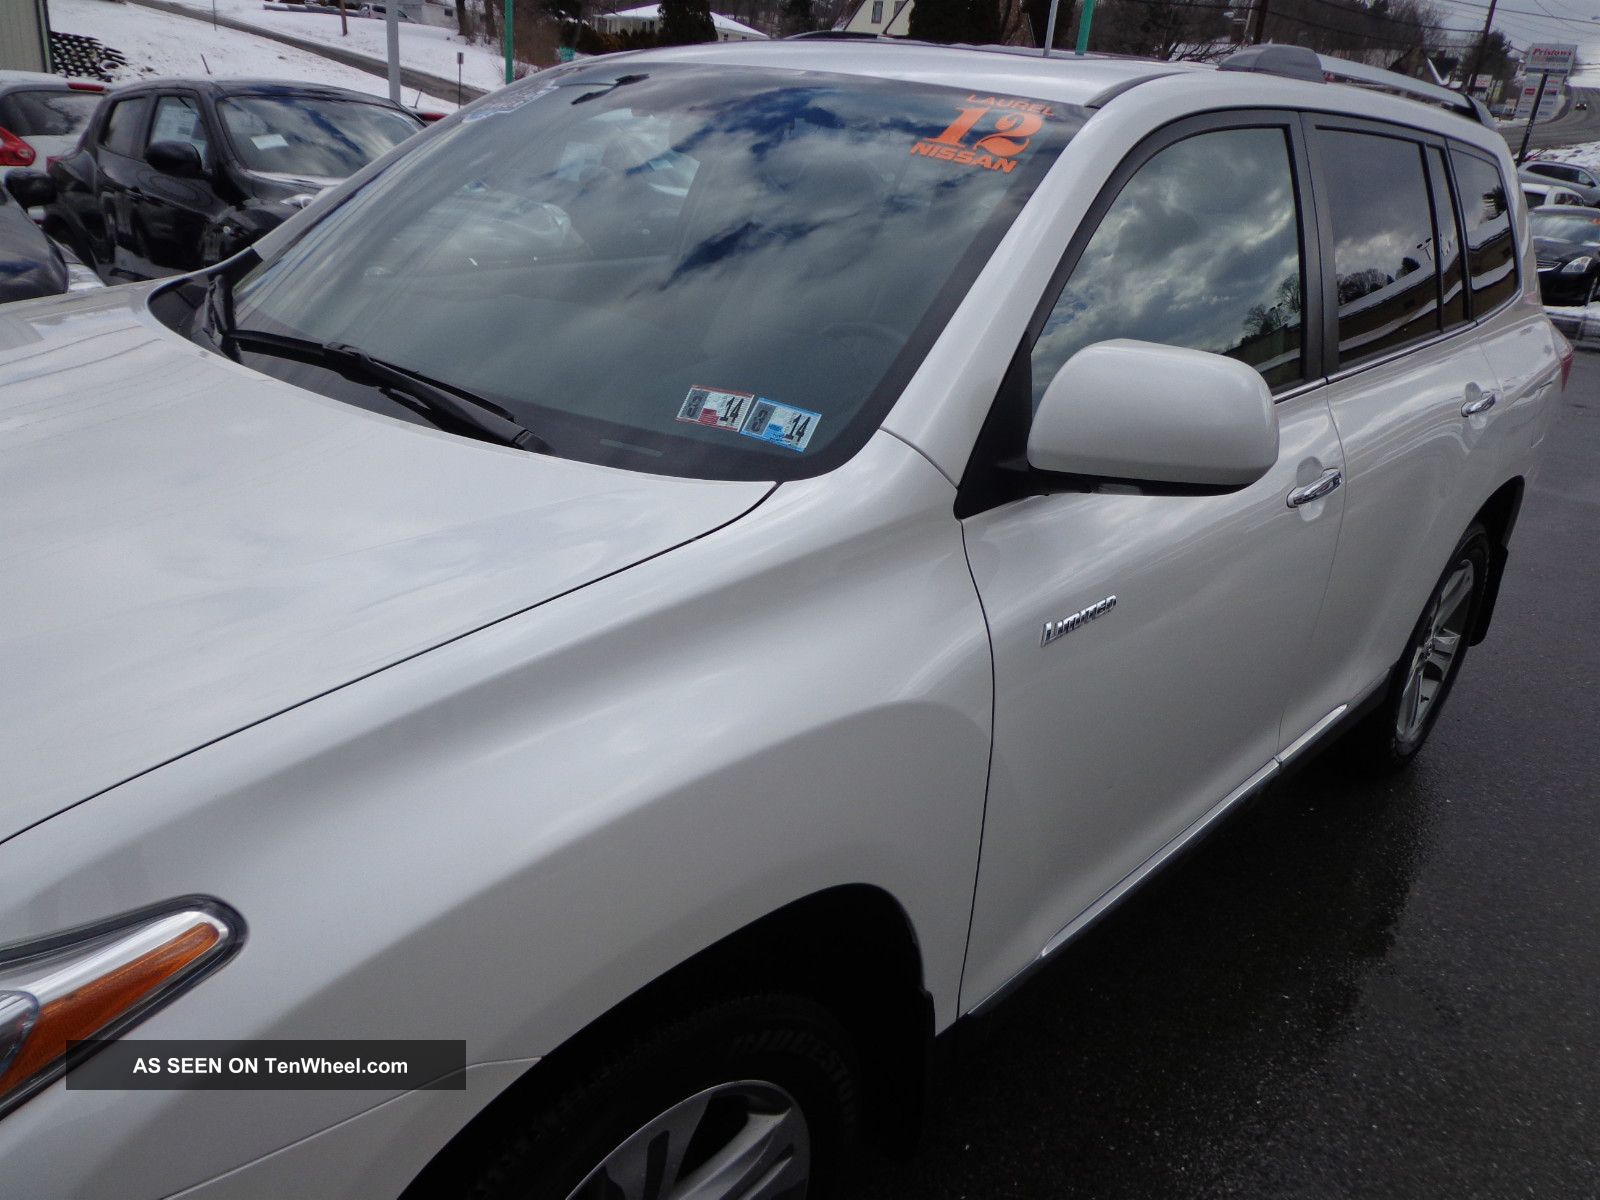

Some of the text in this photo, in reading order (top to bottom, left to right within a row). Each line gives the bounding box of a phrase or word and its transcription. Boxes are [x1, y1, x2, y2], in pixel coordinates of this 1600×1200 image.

[966, 94, 1055, 117] LAUREL
[922, 106, 1044, 158] 12
[910, 142, 1018, 174] NISSAN
[719, 396, 745, 426] 14
[784, 413, 812, 442] 14
